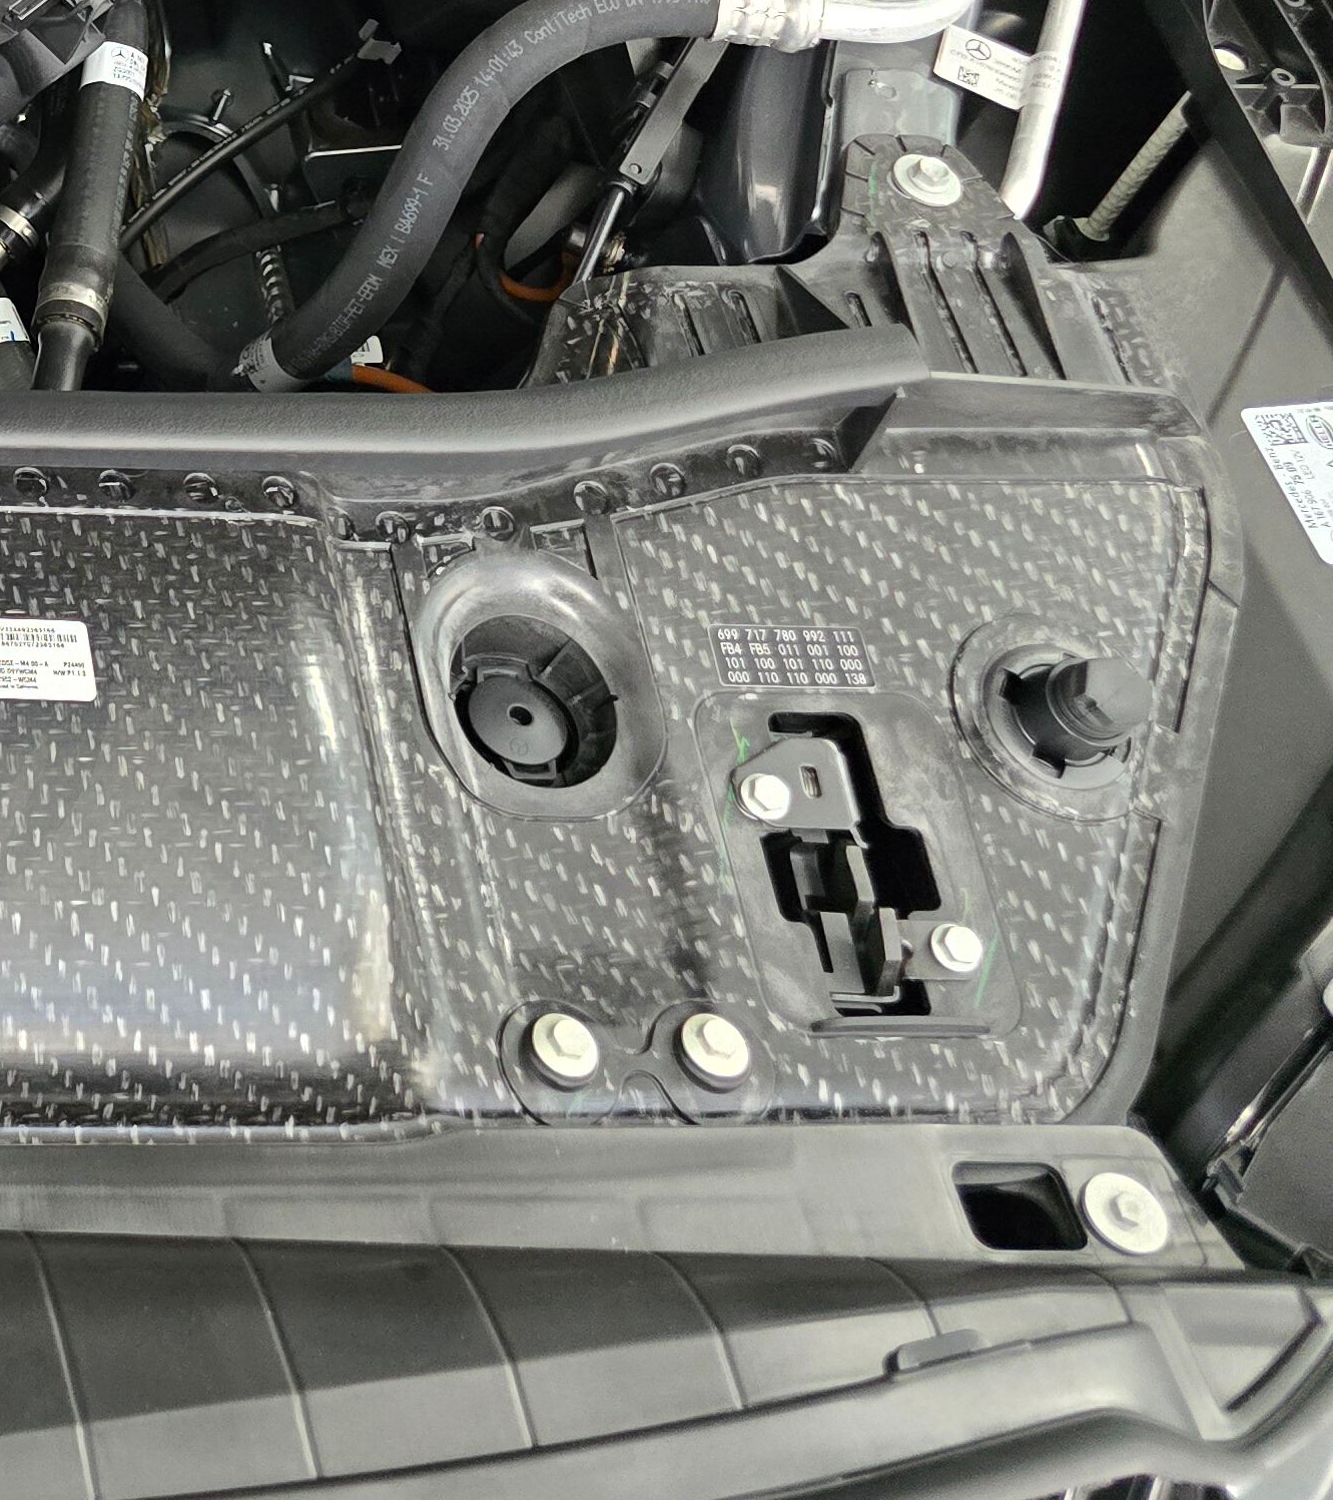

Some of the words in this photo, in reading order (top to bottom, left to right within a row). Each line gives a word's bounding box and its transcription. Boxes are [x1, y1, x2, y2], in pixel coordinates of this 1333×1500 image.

[524, 5, 592, 45] ContiTech
[433, 86, 479, 151] 31.03.2025
[474, 40, 524, 88] 14:01:43
[377, 247, 399, 269] MEX
[421, 172, 434, 187] F
[1265, 447, 1284, 471] Benz
[1285, 481, 1318, 529] Mercedes
[717, 628, 739, 640] 699
[745, 629, 766, 641] 717
[773, 630, 797, 642] 780
[803, 630, 826, 642] 992
[833, 631, 854, 642] 111
[720, 642, 743, 655] FB4
[749, 643, 771, 655] FB5
[778, 644, 800, 656] 011
[807, 644, 829, 656] 001
[837, 645, 858, 656] 100
[726, 657, 745, 669] 101
[754, 658, 775, 670] 100
[783, 658, 804, 670] 101
[812, 659, 833, 670] 110
[840, 659, 862, 671] 000
[728, 671, 750, 683] 000
[758, 672, 779, 683] 110
[787, 672, 808, 684] 110
[815, 673, 837, 684] 000
[845, 673, 867, 685] 138
